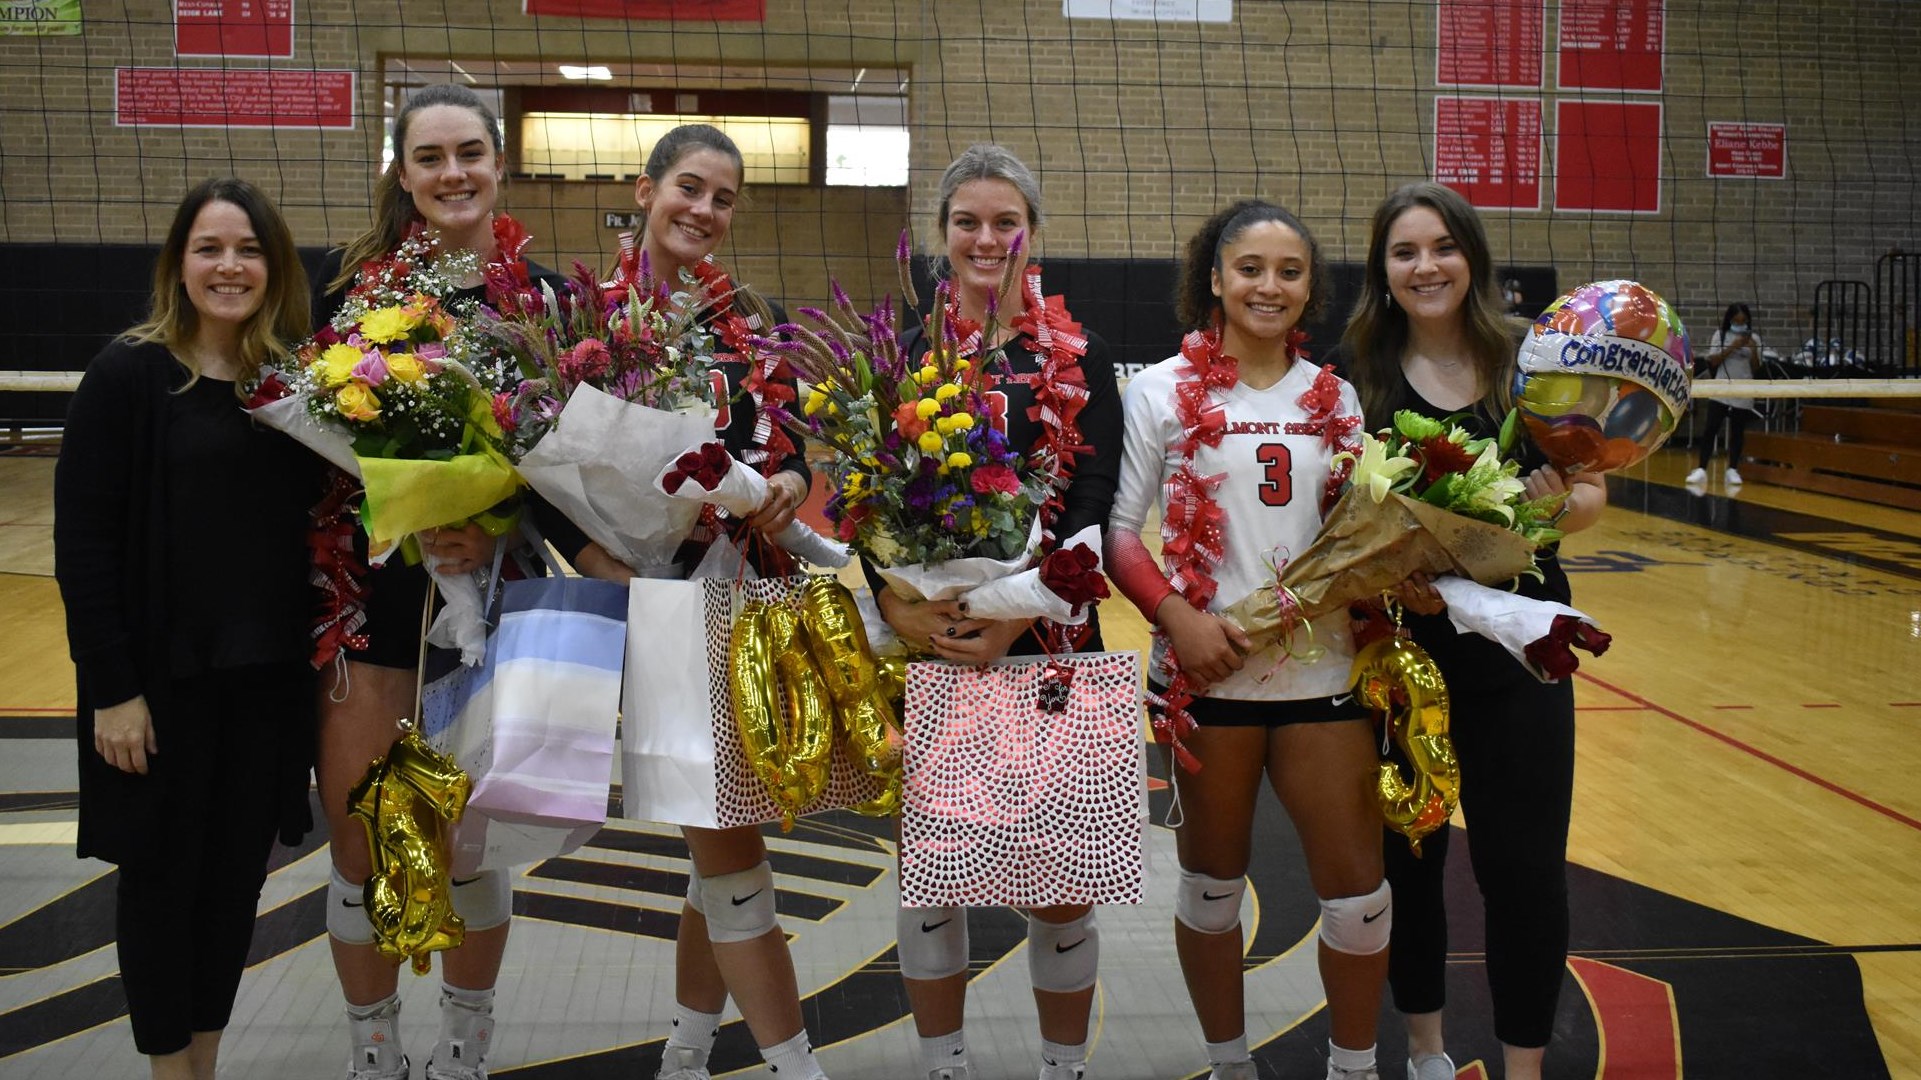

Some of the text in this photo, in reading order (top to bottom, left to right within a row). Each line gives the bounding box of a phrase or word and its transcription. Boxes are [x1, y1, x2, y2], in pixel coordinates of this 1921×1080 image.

[1715, 138, 1780, 150] Eliane Kebbe
[1560, 339, 1687, 407] Congratulation
[1223, 421, 1280, 436] LMONT
[1256, 442, 1292, 507] 3
